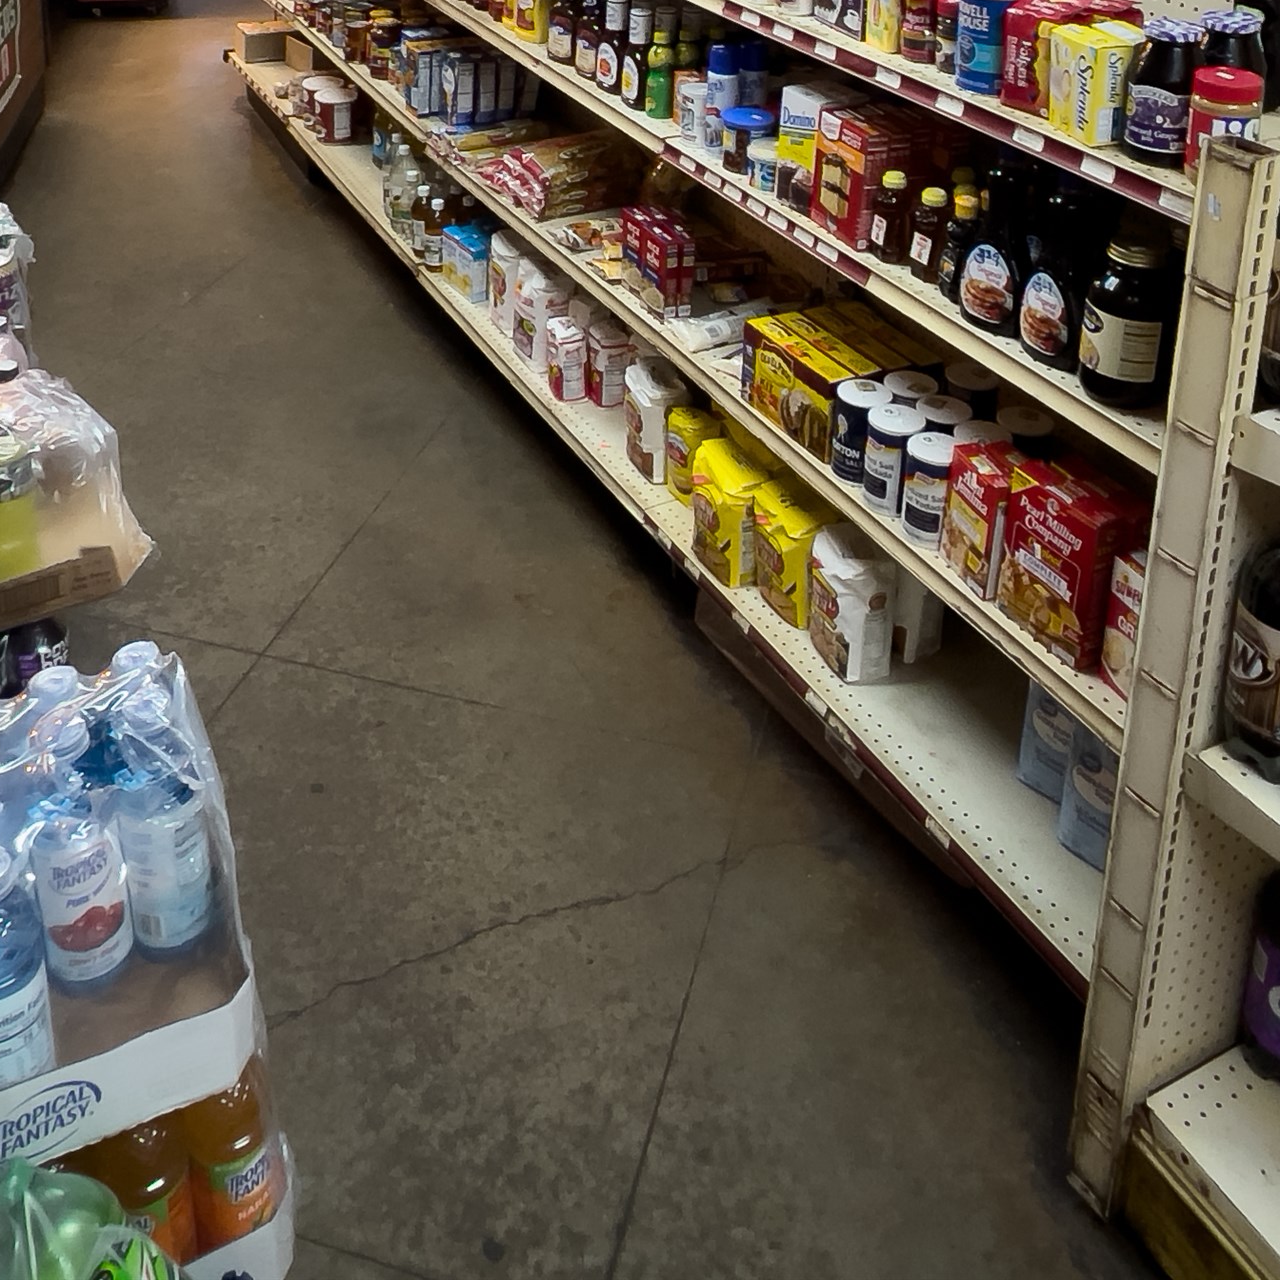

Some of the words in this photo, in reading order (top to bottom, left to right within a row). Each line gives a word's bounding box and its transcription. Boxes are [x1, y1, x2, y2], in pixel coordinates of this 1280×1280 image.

[960, 1, 990, 19] WELL
[783, 106, 817, 128] Domino
[833, 438, 861, 459] ORTON
[1019, 494, 1045, 523] Pearl
[1045, 517, 1083, 551] Milling
[1023, 513, 1072, 556] Company
[0, 1103, 90, 1161] FANTASY
